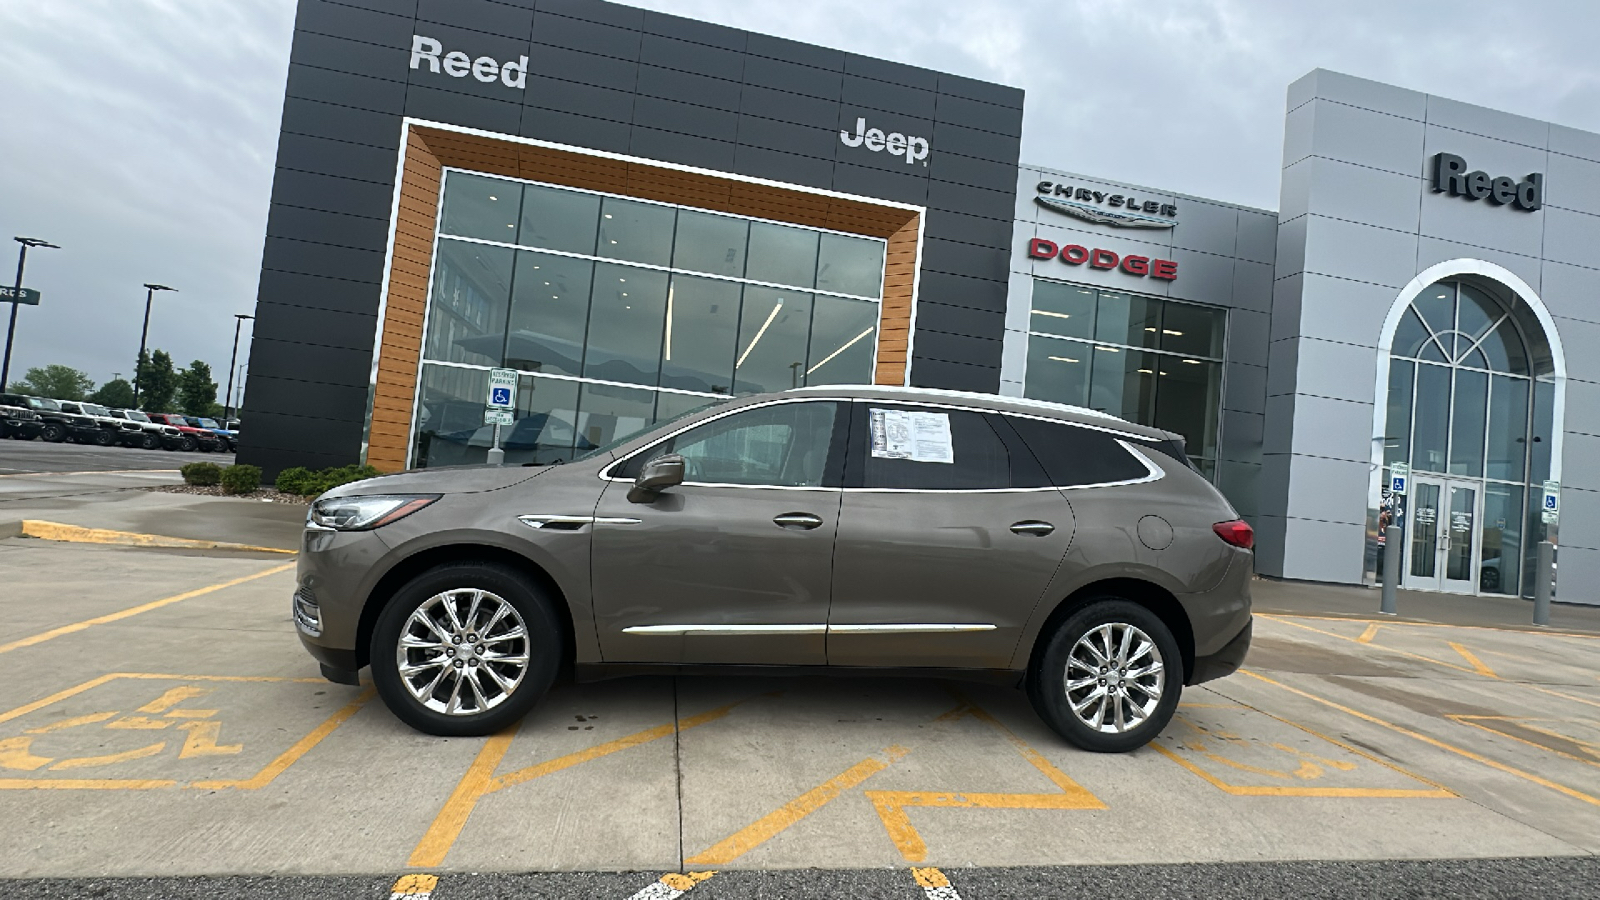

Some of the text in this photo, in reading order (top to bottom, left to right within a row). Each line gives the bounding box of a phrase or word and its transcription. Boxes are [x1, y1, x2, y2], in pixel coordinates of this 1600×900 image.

[410, 35, 529, 89] Reed
[840, 117, 929, 165] Jeep
[1037, 181, 1178, 216] CHRYSLER
[1432, 152, 1542, 212] Reed
[1029, 238, 1178, 280] DODGE
